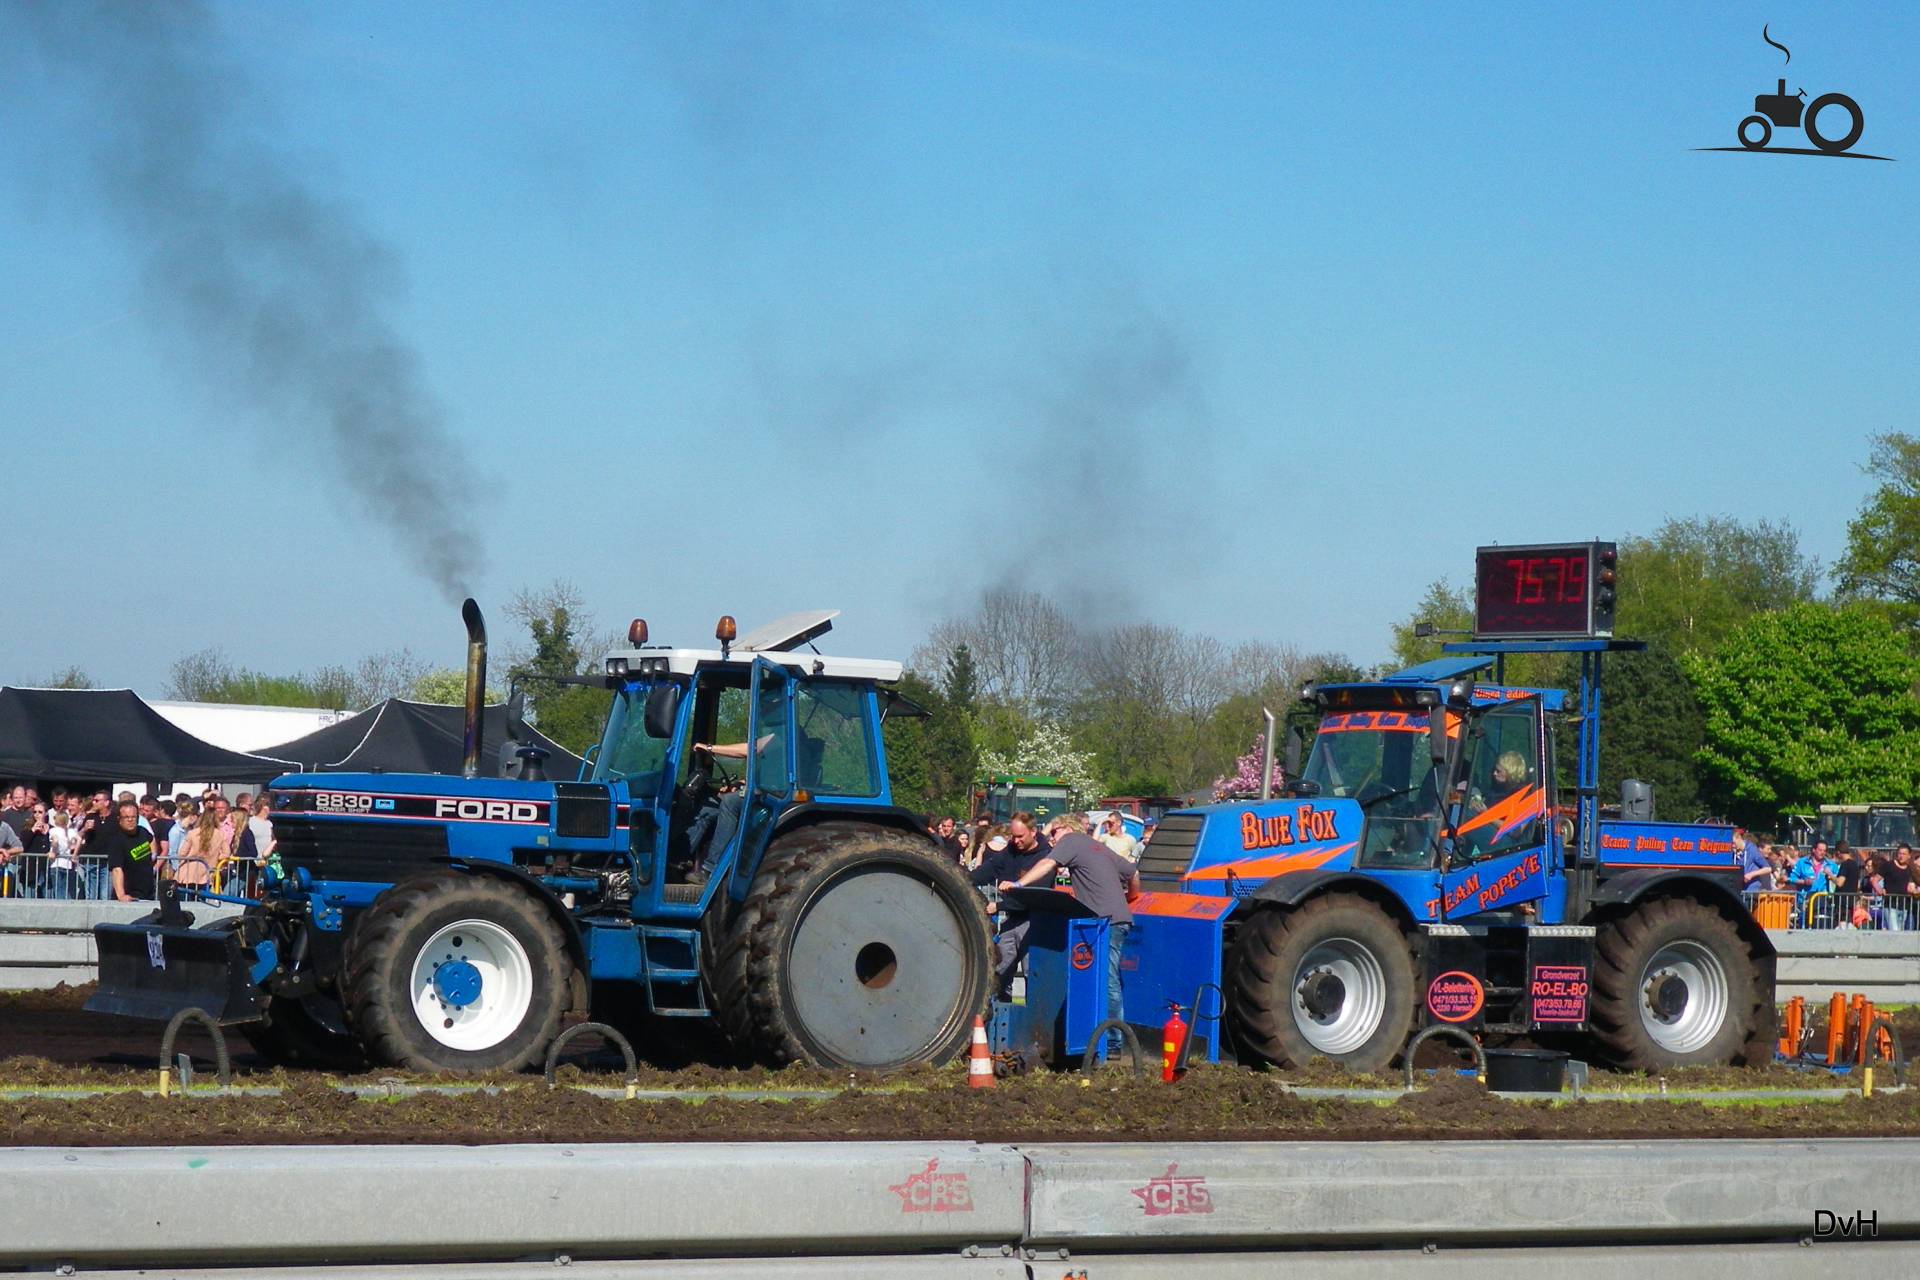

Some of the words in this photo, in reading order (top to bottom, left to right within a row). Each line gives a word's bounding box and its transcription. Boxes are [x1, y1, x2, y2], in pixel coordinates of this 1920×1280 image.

[316, 793, 373, 809] 8830
[435, 799, 538, 822] FORD
[1601, 834, 1631, 849] Tractor
[1635, 836, 1667, 853] Pulling
[1671, 837, 1695, 851] Team
[1479, 854, 1541, 911] POPEYE
[1425, 873, 1481, 918] TEAM
[1531, 981, 1589, 996] RO-EL-BO
[910, 1180, 969, 1207] CRS
[1151, 1182, 1209, 1209] CRS
